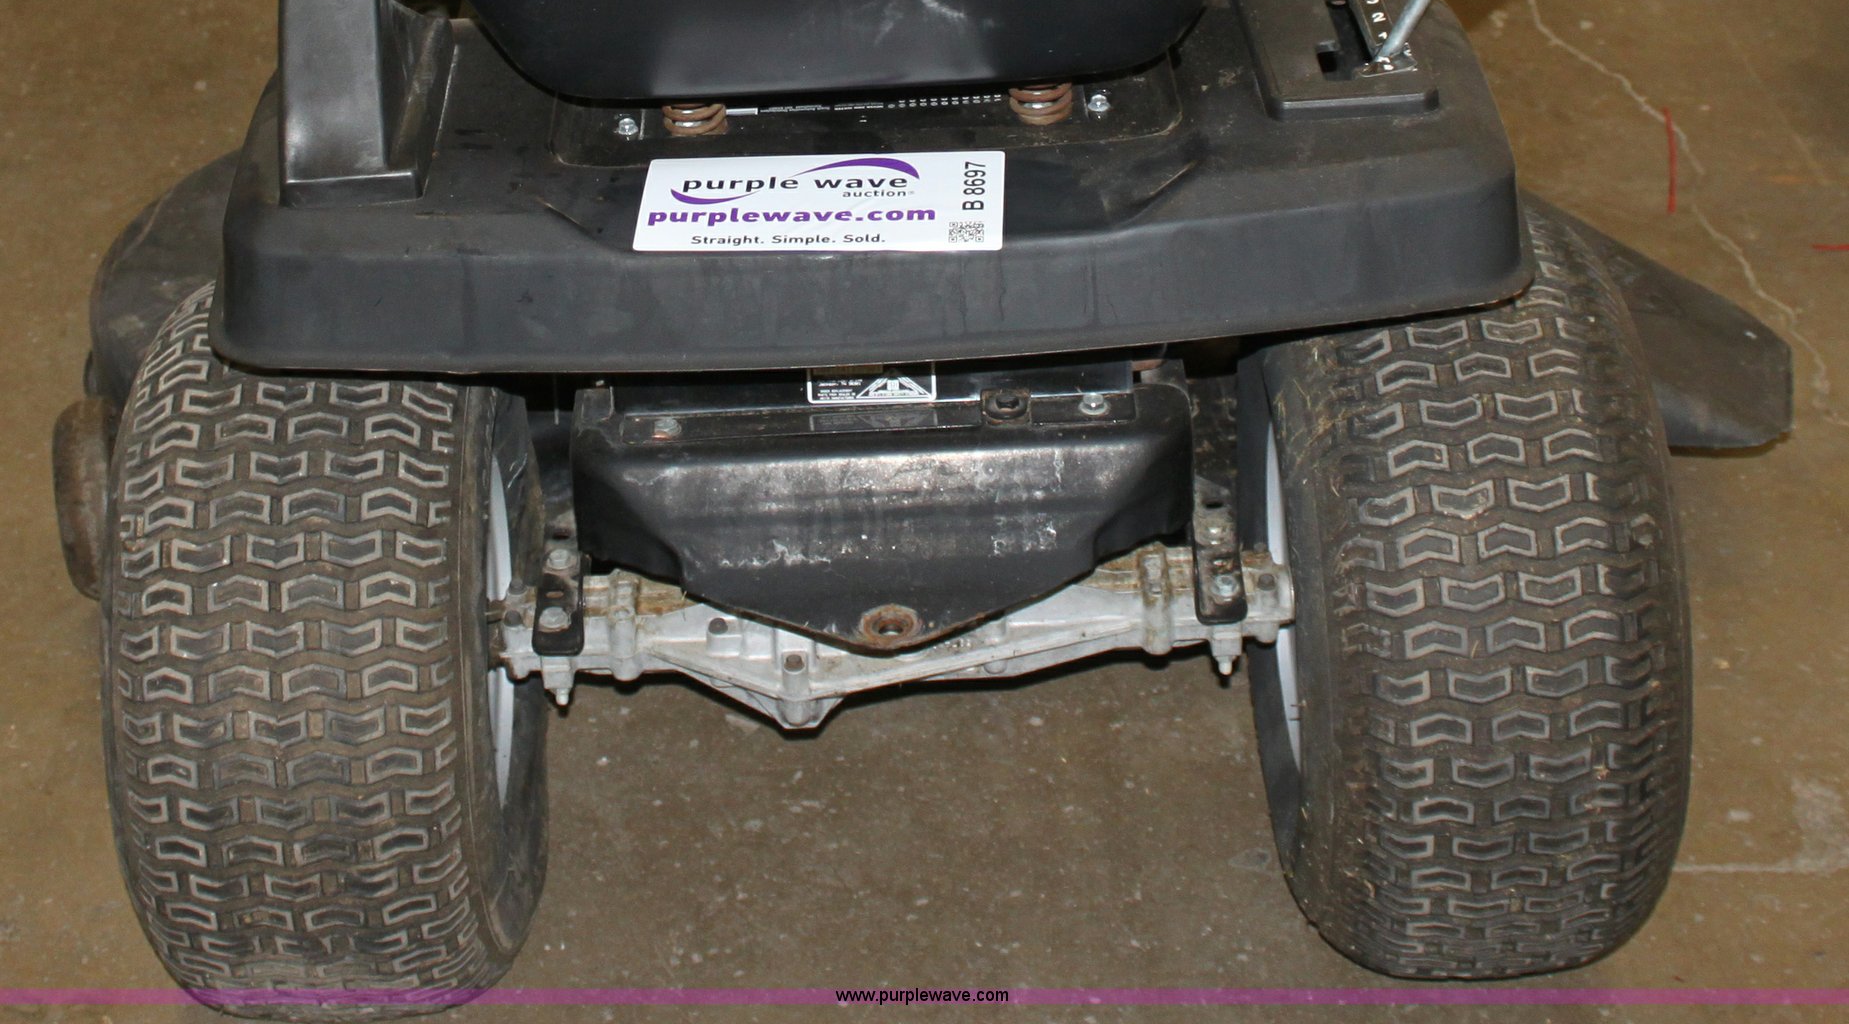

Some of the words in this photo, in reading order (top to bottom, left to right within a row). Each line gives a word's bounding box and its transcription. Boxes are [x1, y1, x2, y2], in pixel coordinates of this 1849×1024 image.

[1371, 12, 1387, 23] 2
[682, 176, 799, 193] purple
[814, 177, 908, 189] wave
[963, 161, 986, 196] 8697
[962, 200, 984, 210] B
[647, 207, 936, 226] purplewave.com
[690, 235, 765, 247] Straight.
[771, 234, 837, 246] Simple.
[842, 233, 887, 244] Sold.
